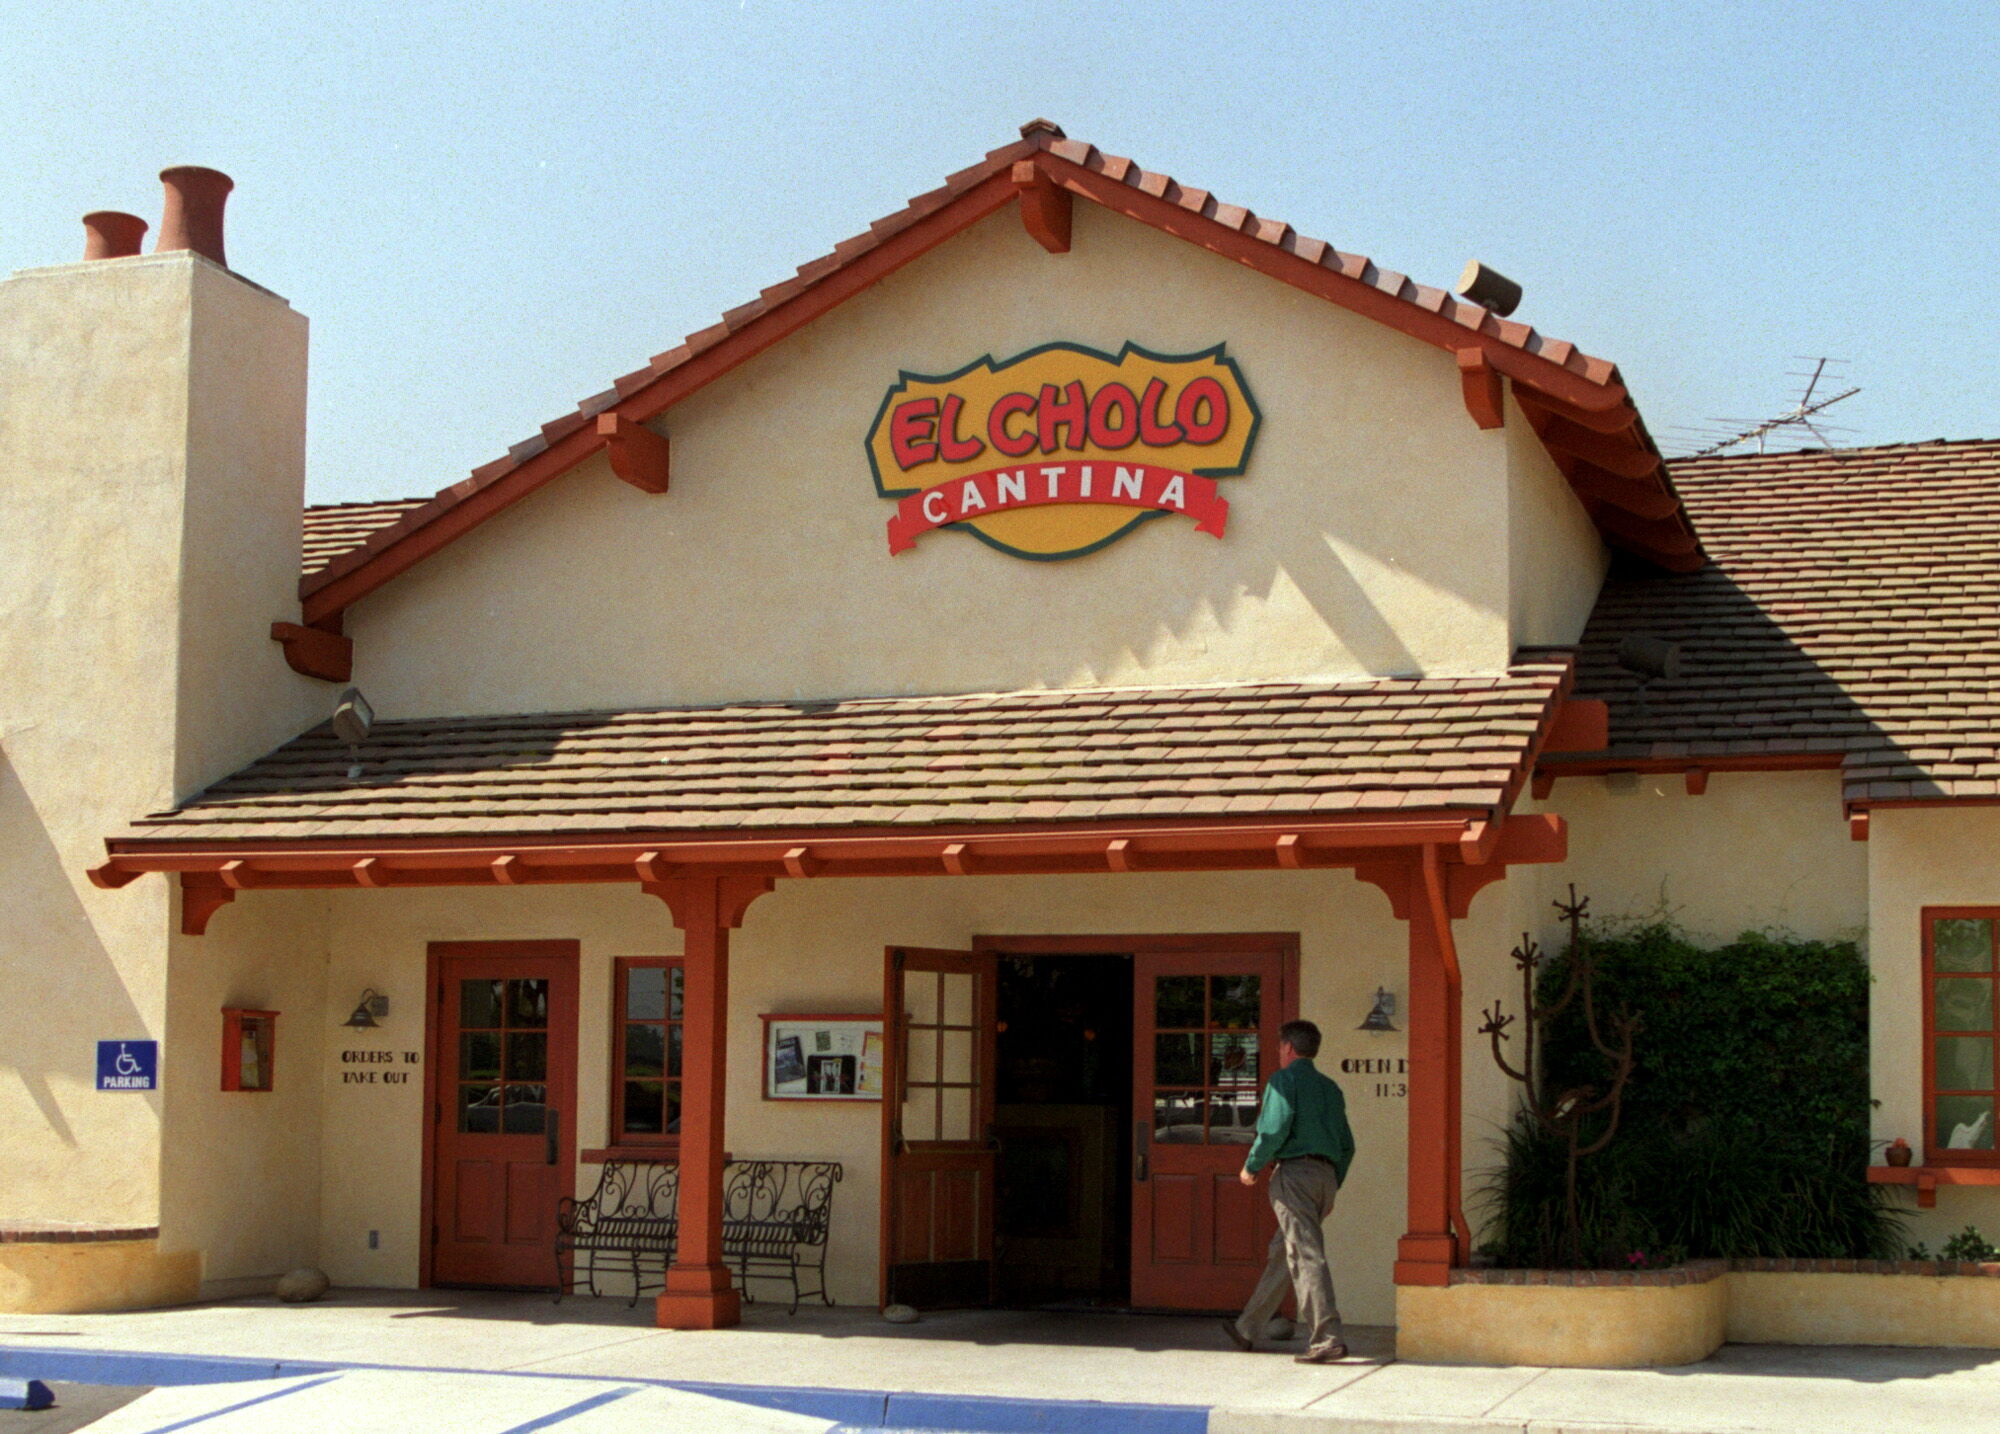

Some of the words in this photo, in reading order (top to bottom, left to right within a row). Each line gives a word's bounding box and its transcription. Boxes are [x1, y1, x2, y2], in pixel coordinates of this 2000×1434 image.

[890, 394, 986, 471] EL
[987, 376, 1230, 457] CHOLO
[923, 465, 1186, 523] CANTINA
[342, 1050, 393, 1063] ORDERS
[402, 1051, 420, 1064] TO
[1341, 1059, 1391, 1073] OPEN
[103, 1075, 150, 1088] PARKING
[342, 1072, 377, 1084] TAKE
[383, 1072, 409, 1084] OUT
[1376, 1083, 1407, 1097] 11:3
